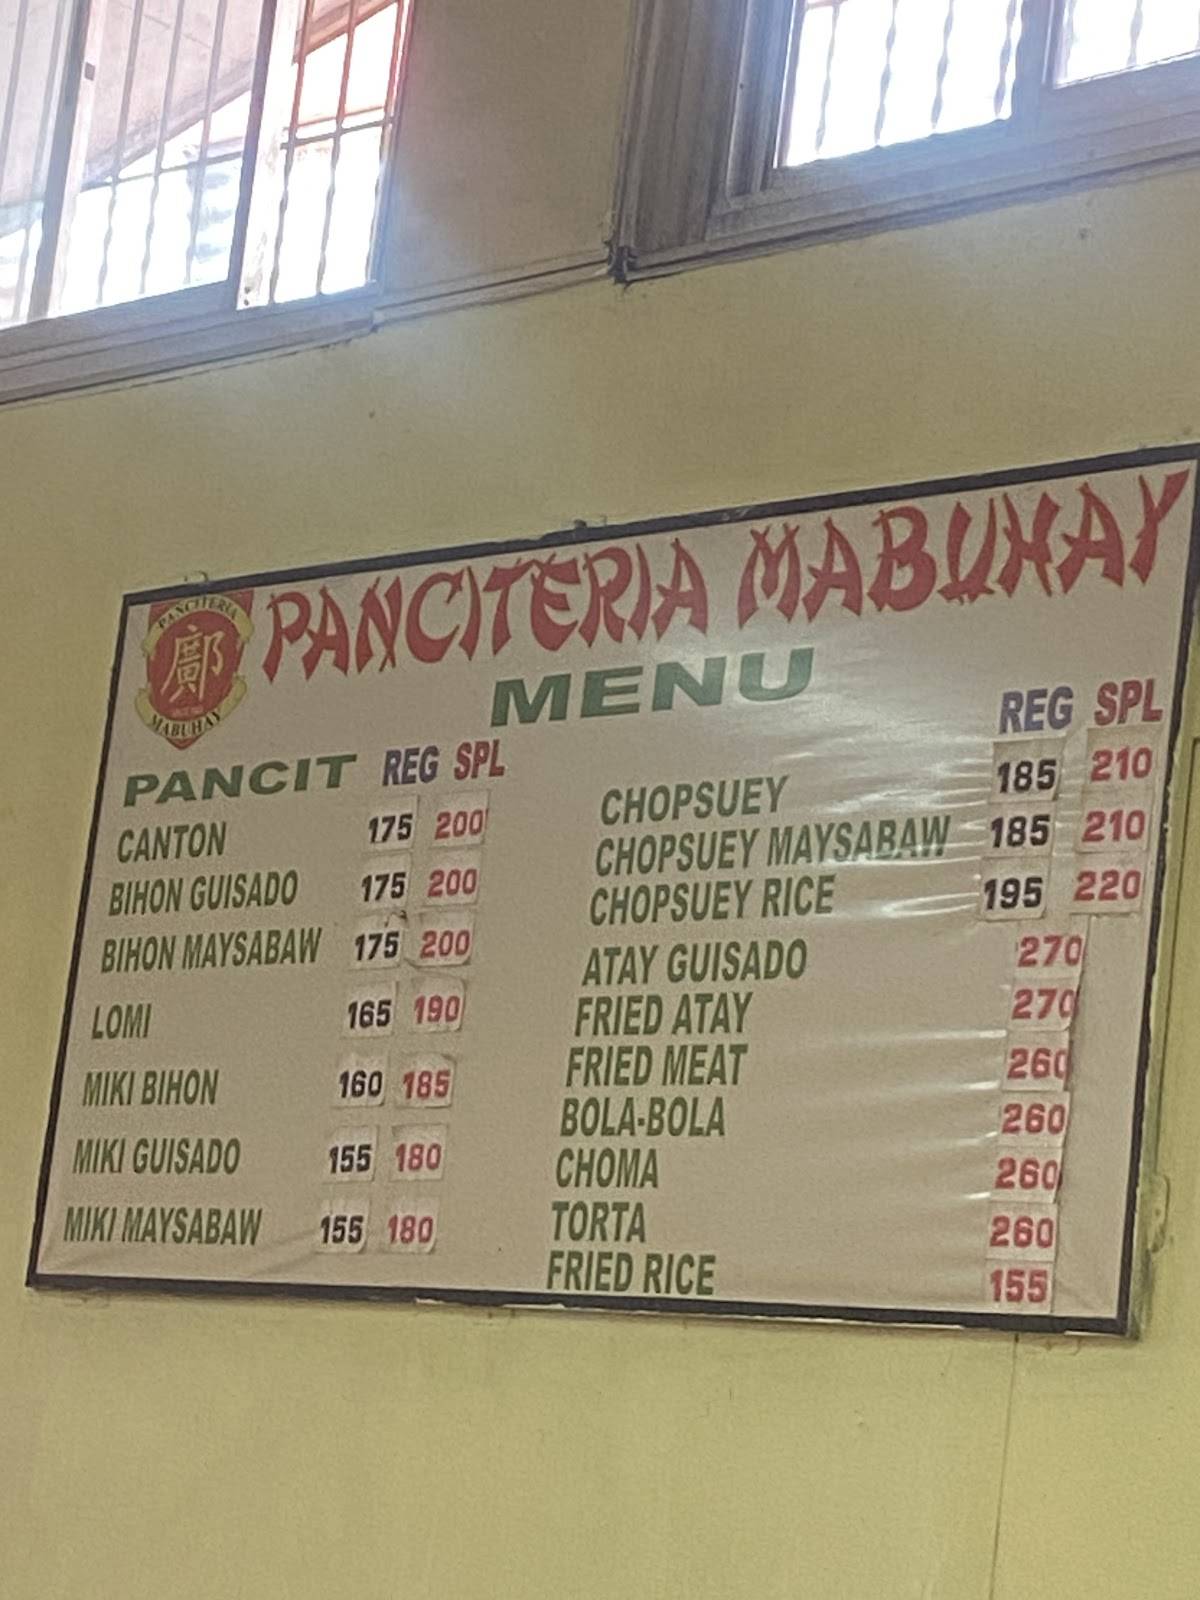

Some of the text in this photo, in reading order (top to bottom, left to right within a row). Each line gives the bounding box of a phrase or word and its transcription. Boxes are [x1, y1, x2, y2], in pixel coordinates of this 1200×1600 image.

[263, 469, 1190, 683] PANCITERIA MABUHAY
[490, 649, 814, 727] MENU
[1000, 680, 1163, 733] REG SPL
[151, 711, 220, 737] MABUHAY
[123, 739, 505, 807] PANCIT REG SPL
[601, 748, 1152, 825] CHOPSUEY 185 210
[117, 809, 483, 863] CANTON 175 200
[596, 809, 1145, 876] CHOPSUEY MAYSABAW 185 210
[109, 869, 478, 915] BIHON GUISADO 175 200
[589, 870, 1141, 925] CHOPSUEY RICE 195 220
[101, 928, 470, 972] BIHON MAYSABAW 175 200
[581, 936, 1083, 986] ATAY GUISADO 270
[92, 995, 460, 1039] LOMI 165 190
[575, 988, 1077, 1036] FRIED ATAY 270
[82, 1069, 450, 1106] MIKI BIHON 160 185
[566, 1044, 1068, 1086] FRIED MEAT 260
[560, 1097, 1065, 1136] BOLA-BOLA 260
[73, 1138, 441, 1174] MIKI GUISADO 155 180
[555, 1148, 1059, 1189] CHOMA 260
[63, 1207, 433, 1245] MIKI MAYSABAW 155 180
[552, 1201, 1053, 1247] TORTA 260
[547, 1251, 1048, 1301] FRIED RICE 155
